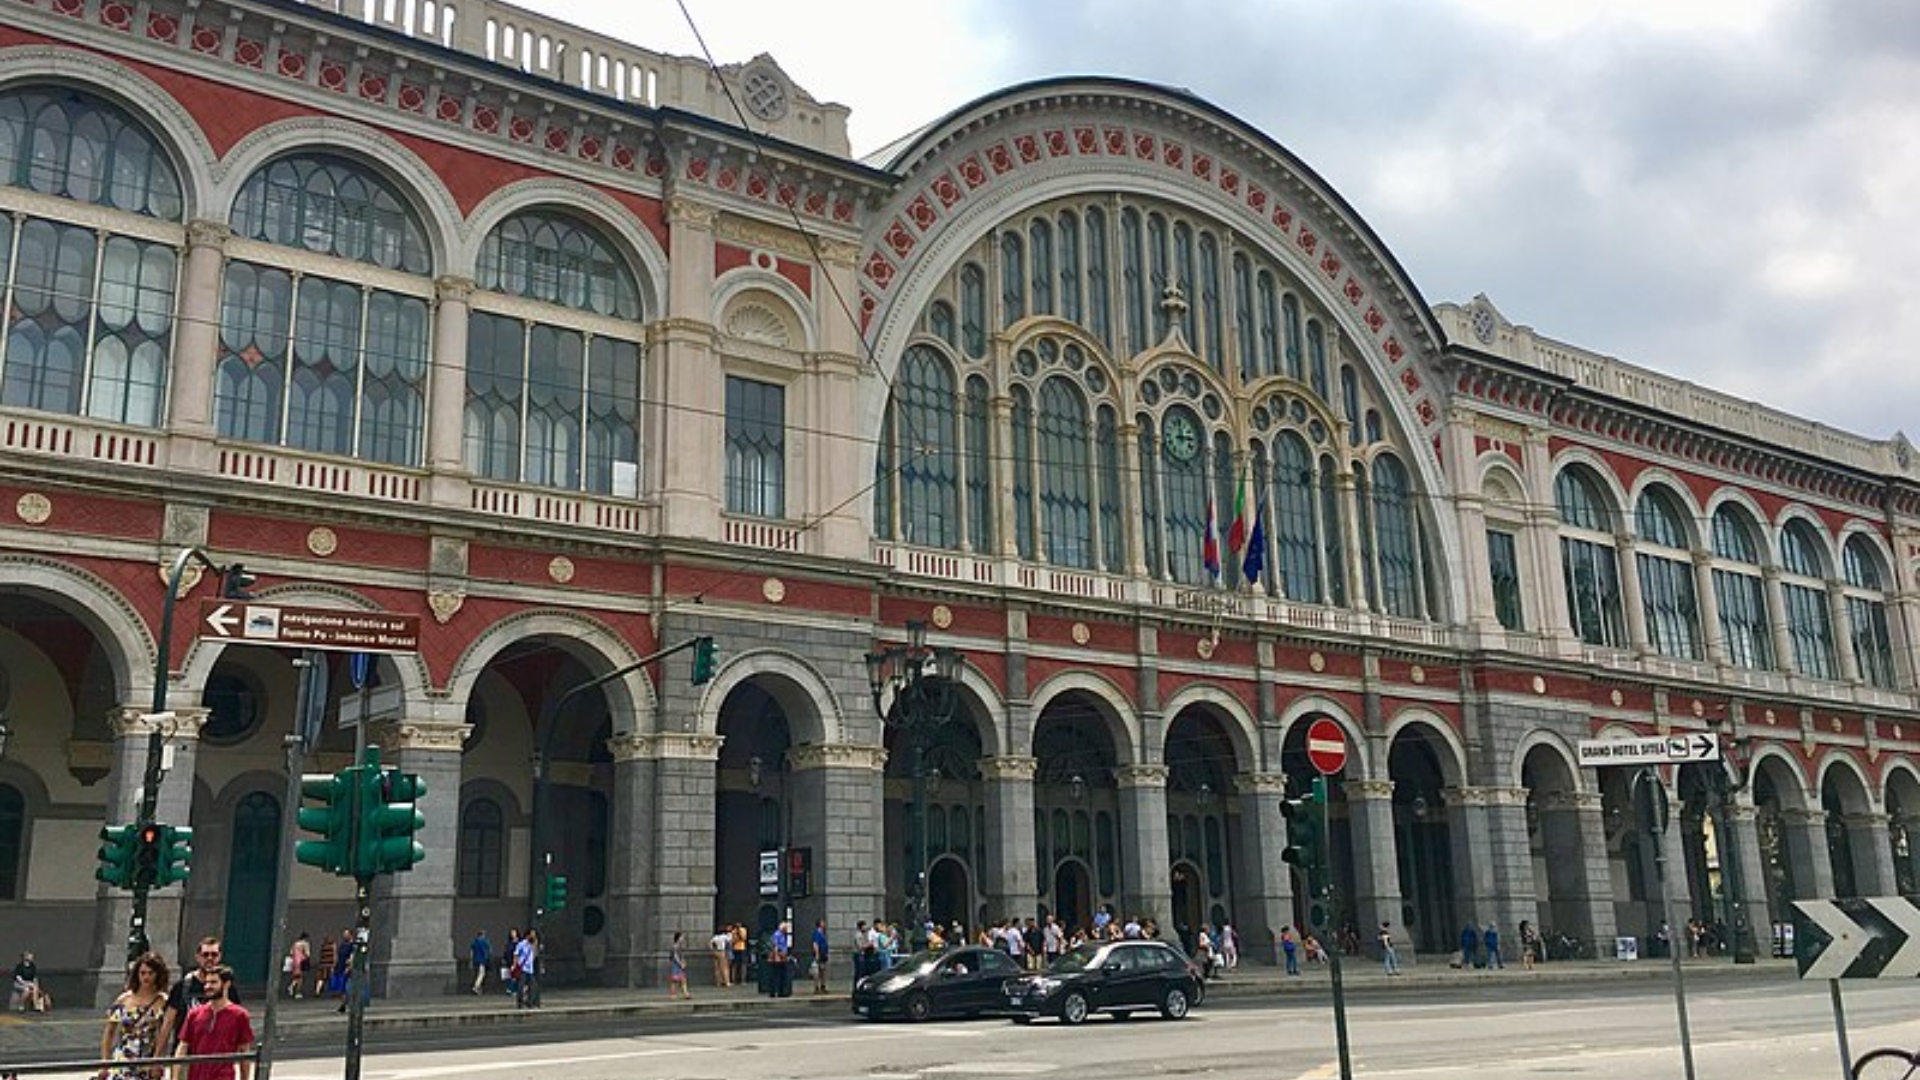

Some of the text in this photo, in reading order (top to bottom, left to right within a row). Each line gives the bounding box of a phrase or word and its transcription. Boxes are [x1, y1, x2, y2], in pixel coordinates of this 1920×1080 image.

[282, 613, 405, 631] navigazione turistica sul
[282, 627, 310, 638] fiume
[313, 630, 326, 640] Po
[335, 631, 376, 643] imbarco
[1581, 745, 1611, 758] GRAND
[1612, 744, 1640, 756] HOTEL
